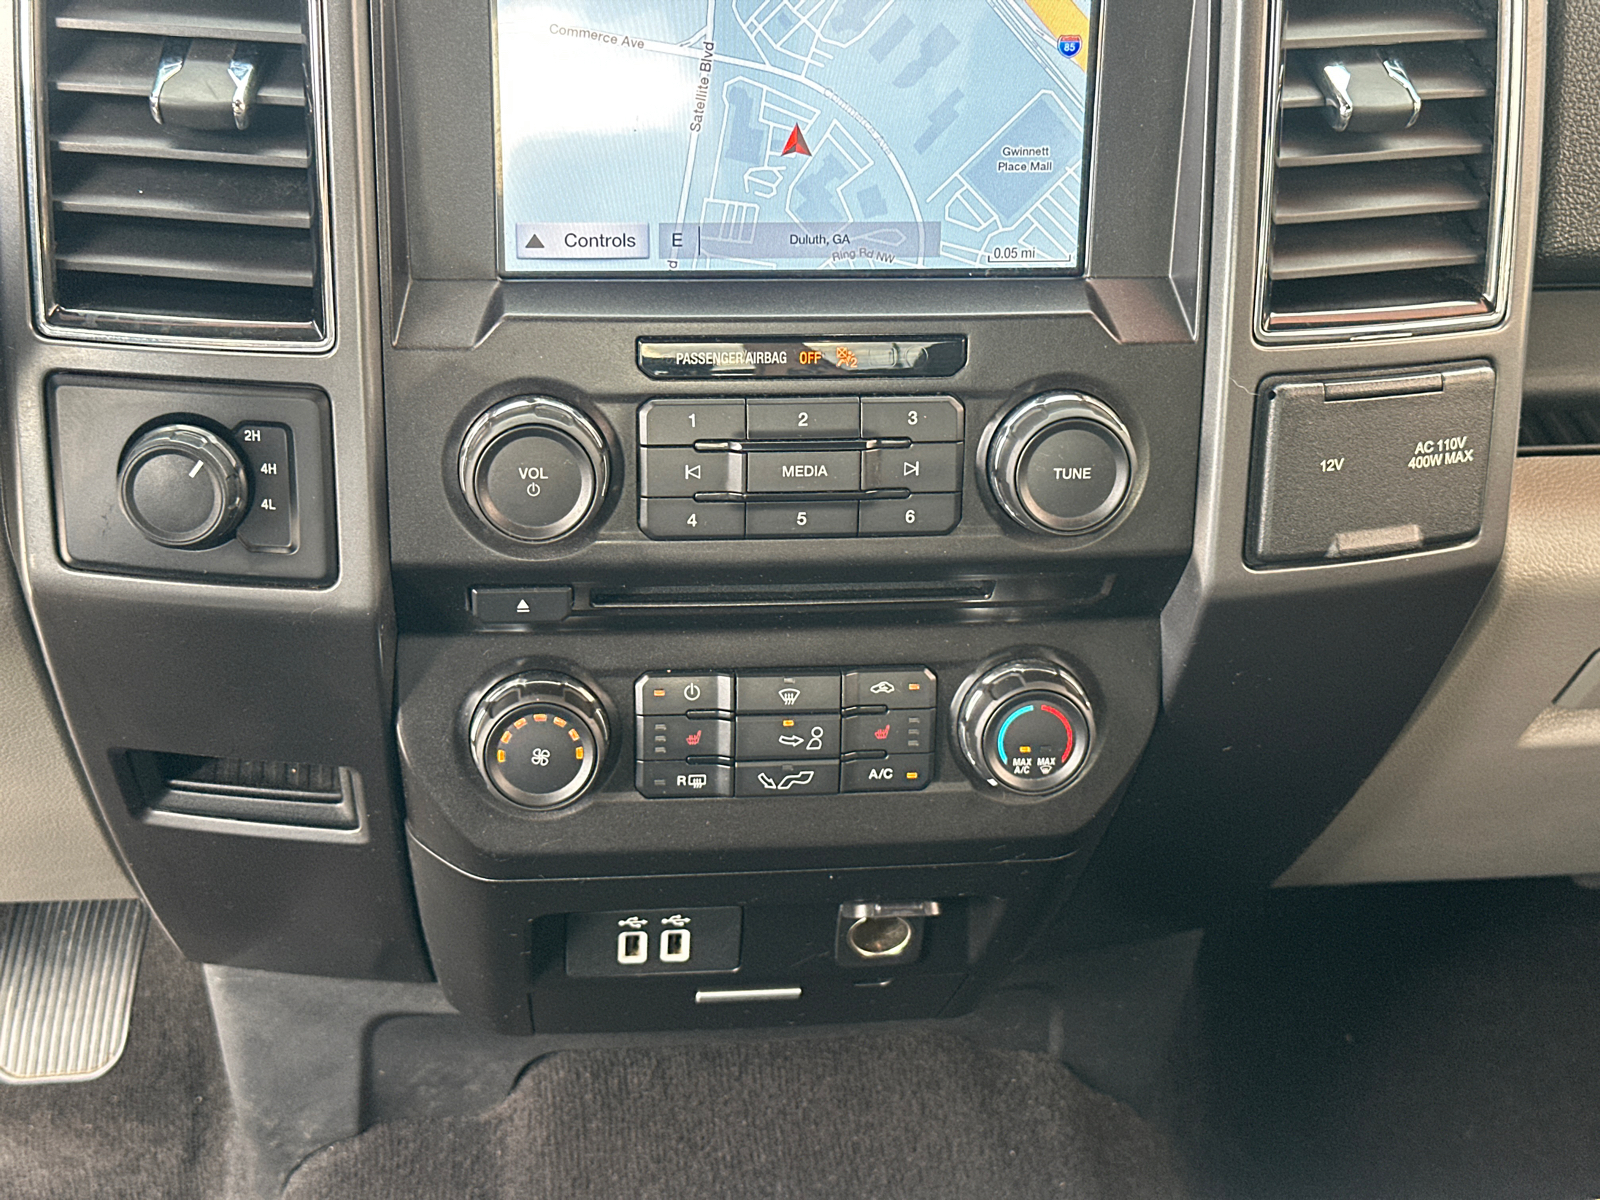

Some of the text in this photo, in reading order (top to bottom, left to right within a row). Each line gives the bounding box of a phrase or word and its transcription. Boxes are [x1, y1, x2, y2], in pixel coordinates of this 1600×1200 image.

[549, 23, 645, 49] Commerce Ave
[1063, 42, 1076, 52] 85
[690, 41, 715, 132] Satellite Blvd
[1002, 147, 1049, 157] Gwinnett
[998, 162, 1052, 171] Place Mall
[564, 232, 636, 249] Controls
[672, 233, 683, 247] E
[789, 234, 850, 246] Duluth, GA
[832, 248, 895, 263] Ring Rd NW
[993, 247, 1036, 259] 0.05 mi
[676, 351, 822, 365] PASSENGER AIRBAG OFF
[688, 413, 697, 428] 1
[798, 412, 808, 427] 2
[908, 411, 918, 425] 3
[244, 430, 261, 442] 2H
[1415, 436, 1468, 454] AC 110V
[1320, 458, 1345, 472] 12V
[1407, 449, 1474, 470] 400W MAX
[260, 463, 277, 475] 4H
[518, 467, 549, 480] VOL
[782, 465, 828, 477] MEDIA
[1053, 467, 1092, 480] TUNE
[260, 499, 276, 511] 4L
[687, 513, 697, 527] 4
[796, 512, 807, 526] 5
[905, 510, 916, 523] 6
[1012, 758, 1032, 766] MAX
[1037, 757, 1056, 766] MAX
[868, 767, 893, 780] A/C
[1014, 766, 1030, 774] A/C
[677, 775, 686, 786] R
